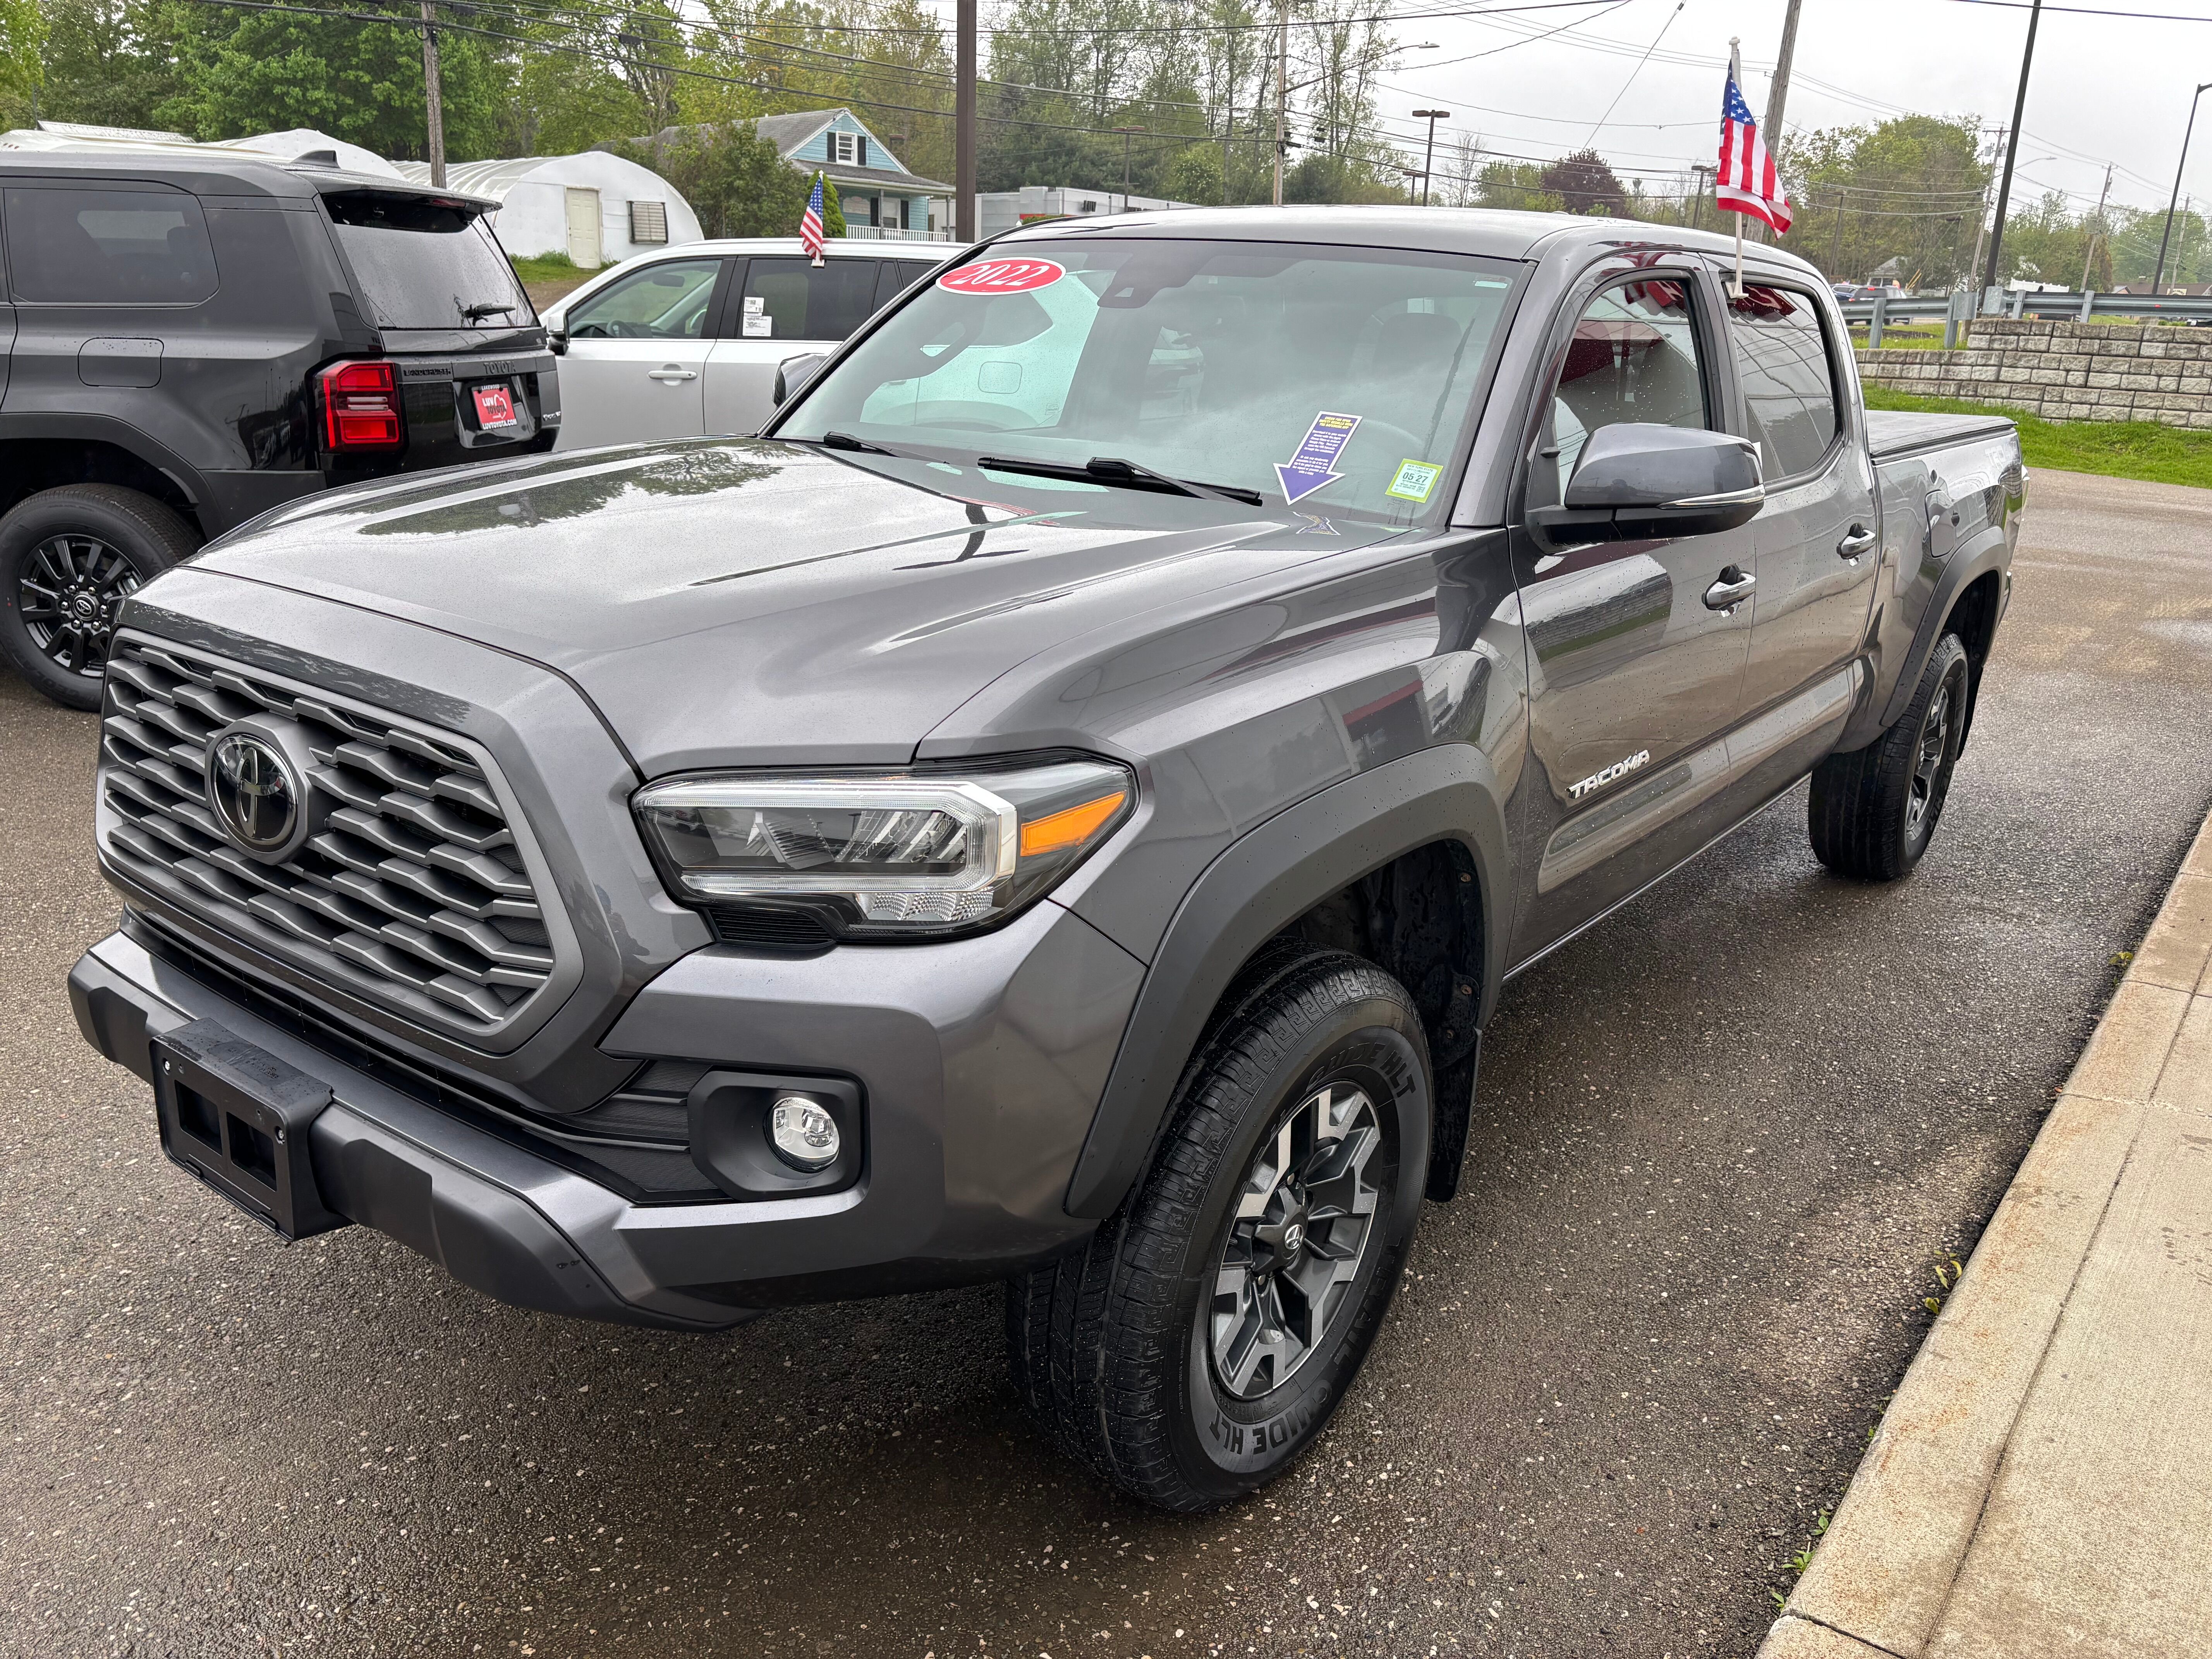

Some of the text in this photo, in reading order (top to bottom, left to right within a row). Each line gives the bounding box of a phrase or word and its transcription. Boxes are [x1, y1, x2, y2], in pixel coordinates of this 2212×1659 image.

[948, 264, 1050, 286] 2022
[484, 361, 516, 374] TOYOTA
[482, 397, 494, 407] LUV
[487, 405, 507, 414] TOYOTA
[482, 418, 517, 430] LUVTOYOTA.COM
[1565, 749, 1650, 799] TACOMA
[1379, 1050, 1416, 1098] HLT
[1209, 1379, 1333, 1455] GUIDE HLT
